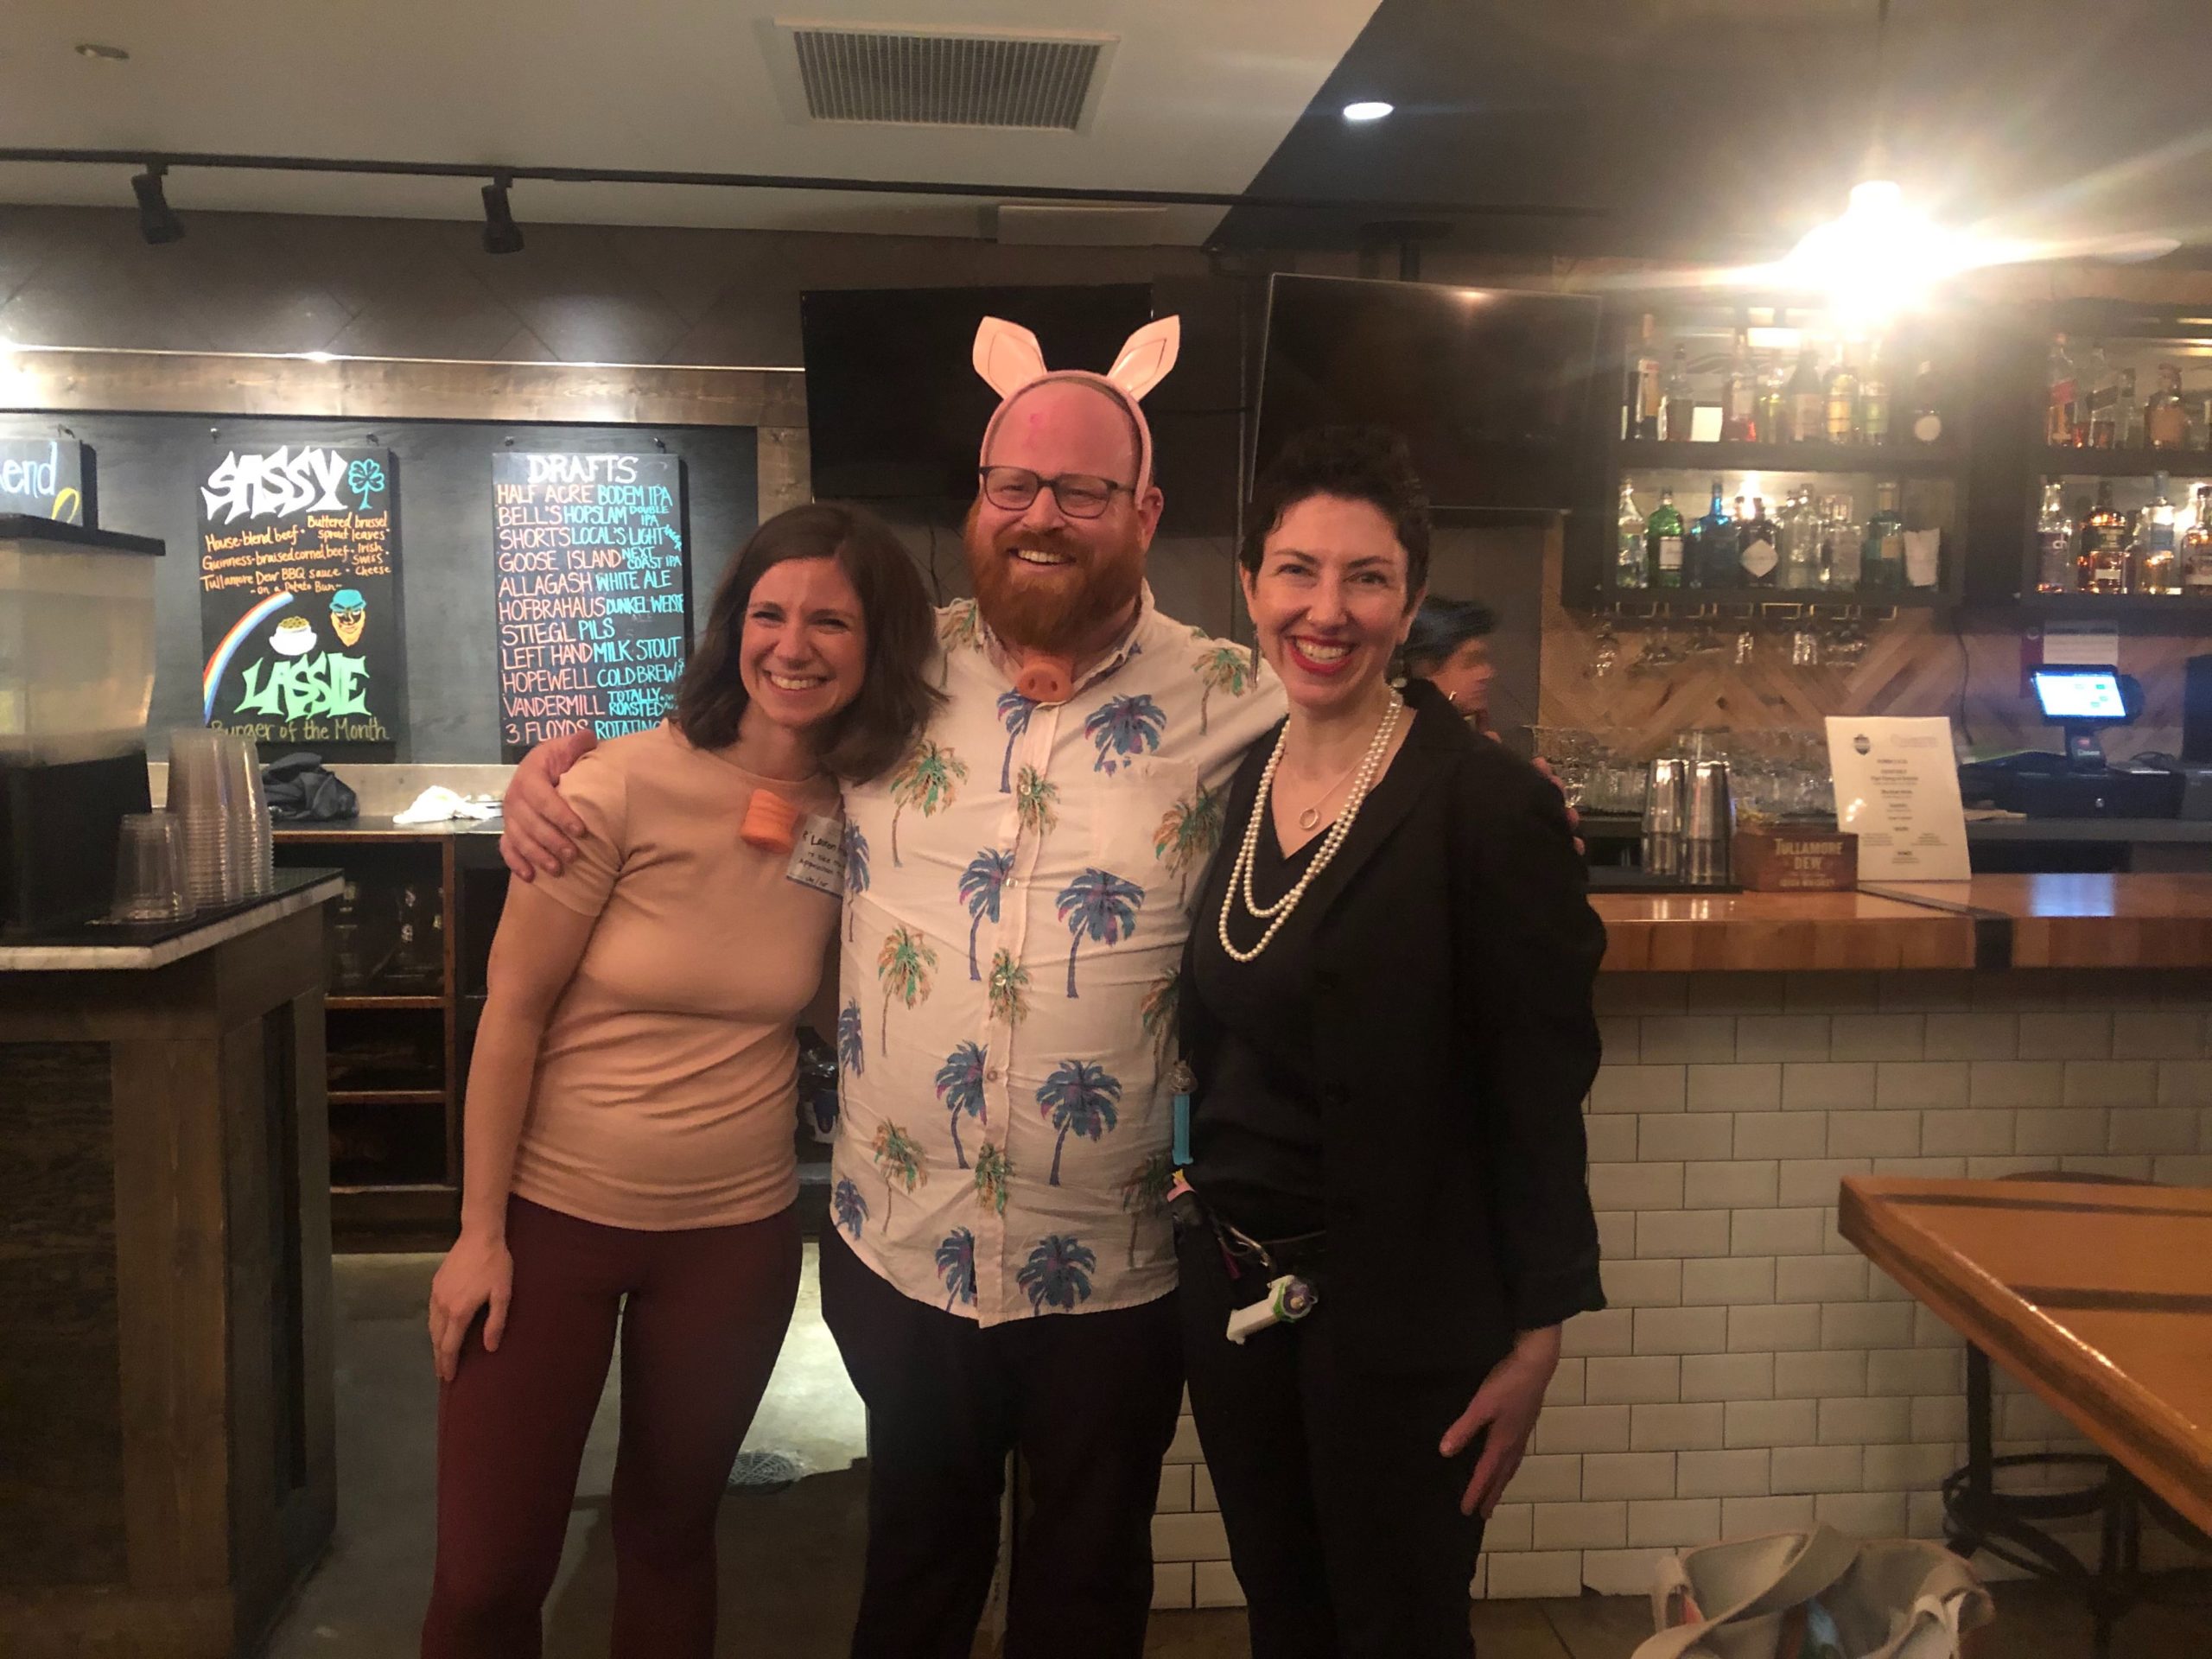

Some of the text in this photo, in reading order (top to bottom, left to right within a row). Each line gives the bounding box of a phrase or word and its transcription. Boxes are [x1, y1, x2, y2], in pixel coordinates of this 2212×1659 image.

[0, 439, 58, 499] end
[526, 454, 639, 485] DRAFTS
[200, 445, 348, 525] SASSY
[497, 484, 674, 507] HALF ACRE BODEM IPA
[308, 511, 353, 529] Buttered
[499, 505, 628, 527] BELL'S HOPSLAM
[629, 505, 671, 516] DOUBLE
[640, 513, 660, 528] IPA
[273, 524, 299, 545] beef
[352, 528, 385, 542] leaves
[499, 525, 667, 551] SHORTS LOCAL'S LIGHT
[295, 543, 327, 560] corned
[326, 543, 350, 563] beef
[358, 541, 384, 554] Irish
[621, 546, 656, 561] NEXT
[499, 549, 622, 573] GOOSE ISLAND
[626, 554, 683, 570] COAST IPA
[200, 567, 342, 592] Tullamore Dew BBQ sauce
[498, 569, 673, 599] ALLAGASH WHITE ALE
[499, 596, 607, 623] HOFBRAHAUS
[606, 595, 652, 616] DUNKEL
[501, 617, 616, 646] STIEGL PILS
[501, 635, 683, 671] LEFT HAND MILK STOUT
[233, 651, 372, 723] LASSIE
[502, 667, 597, 694] HOPEWELL
[596, 667, 637, 688] COLD
[636, 661, 678, 684] BREW
[502, 694, 607, 718] VANDERMILL
[608, 701, 665, 718] ROASTED
[607, 687, 663, 703] TOTALLY
[279, 721, 298, 742] of
[303, 718, 329, 741] the
[334, 716, 389, 741] Month
[505, 723, 521, 744] 3
